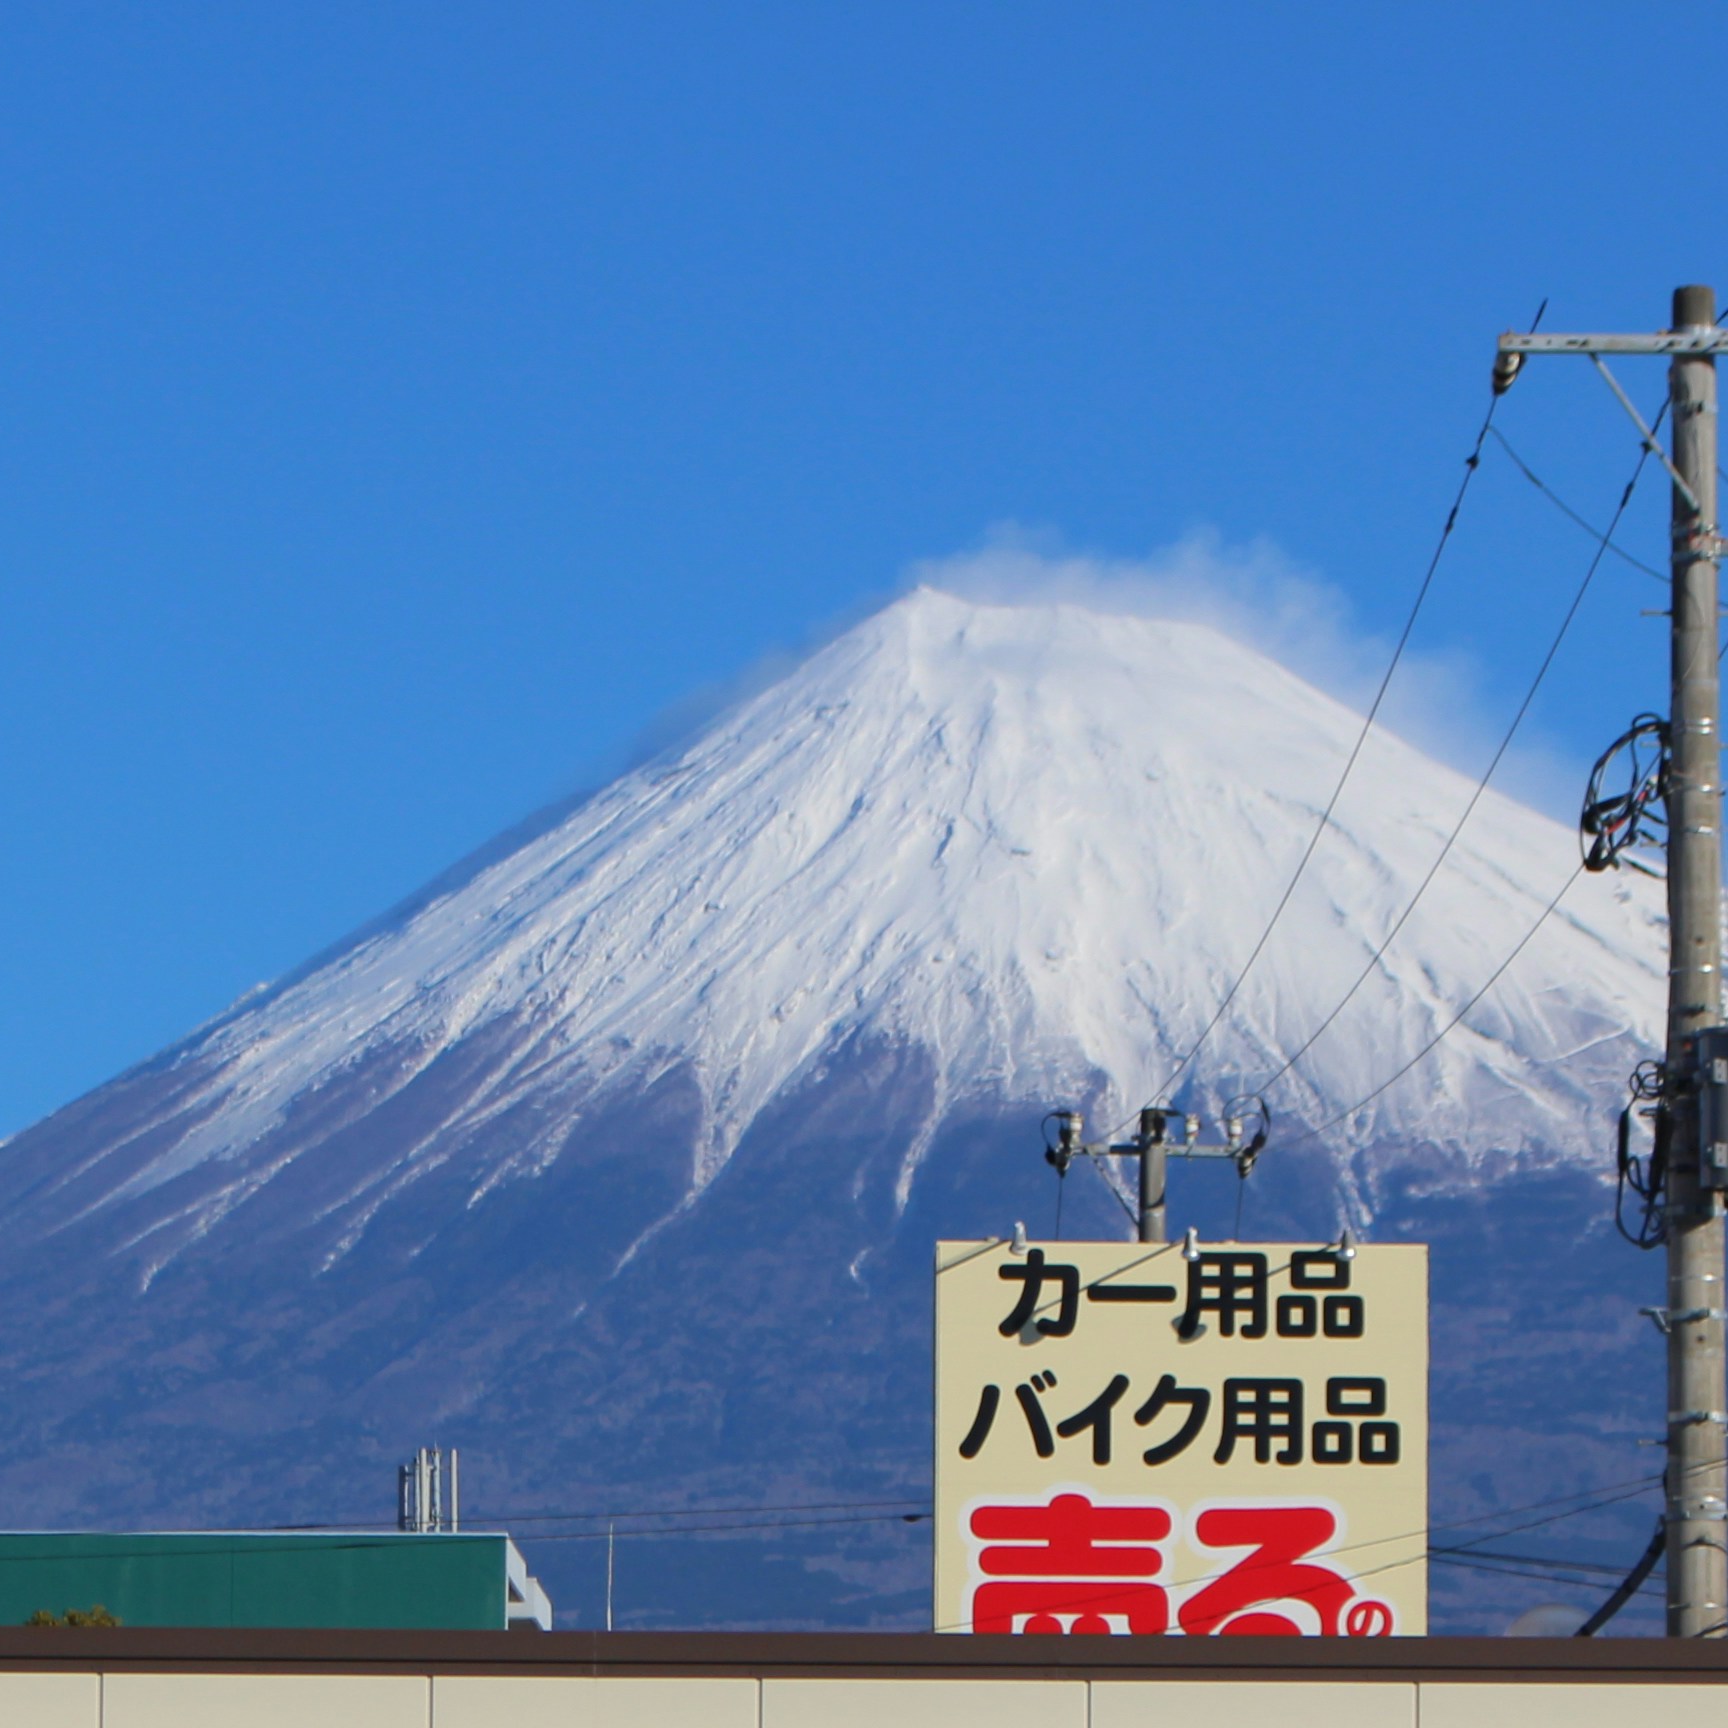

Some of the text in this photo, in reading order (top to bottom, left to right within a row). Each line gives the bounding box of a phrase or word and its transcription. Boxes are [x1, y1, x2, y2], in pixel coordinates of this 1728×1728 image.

[999, 1248, 1364, 1339] カー用品
[960, 1368, 1400, 1466] バイク用品
